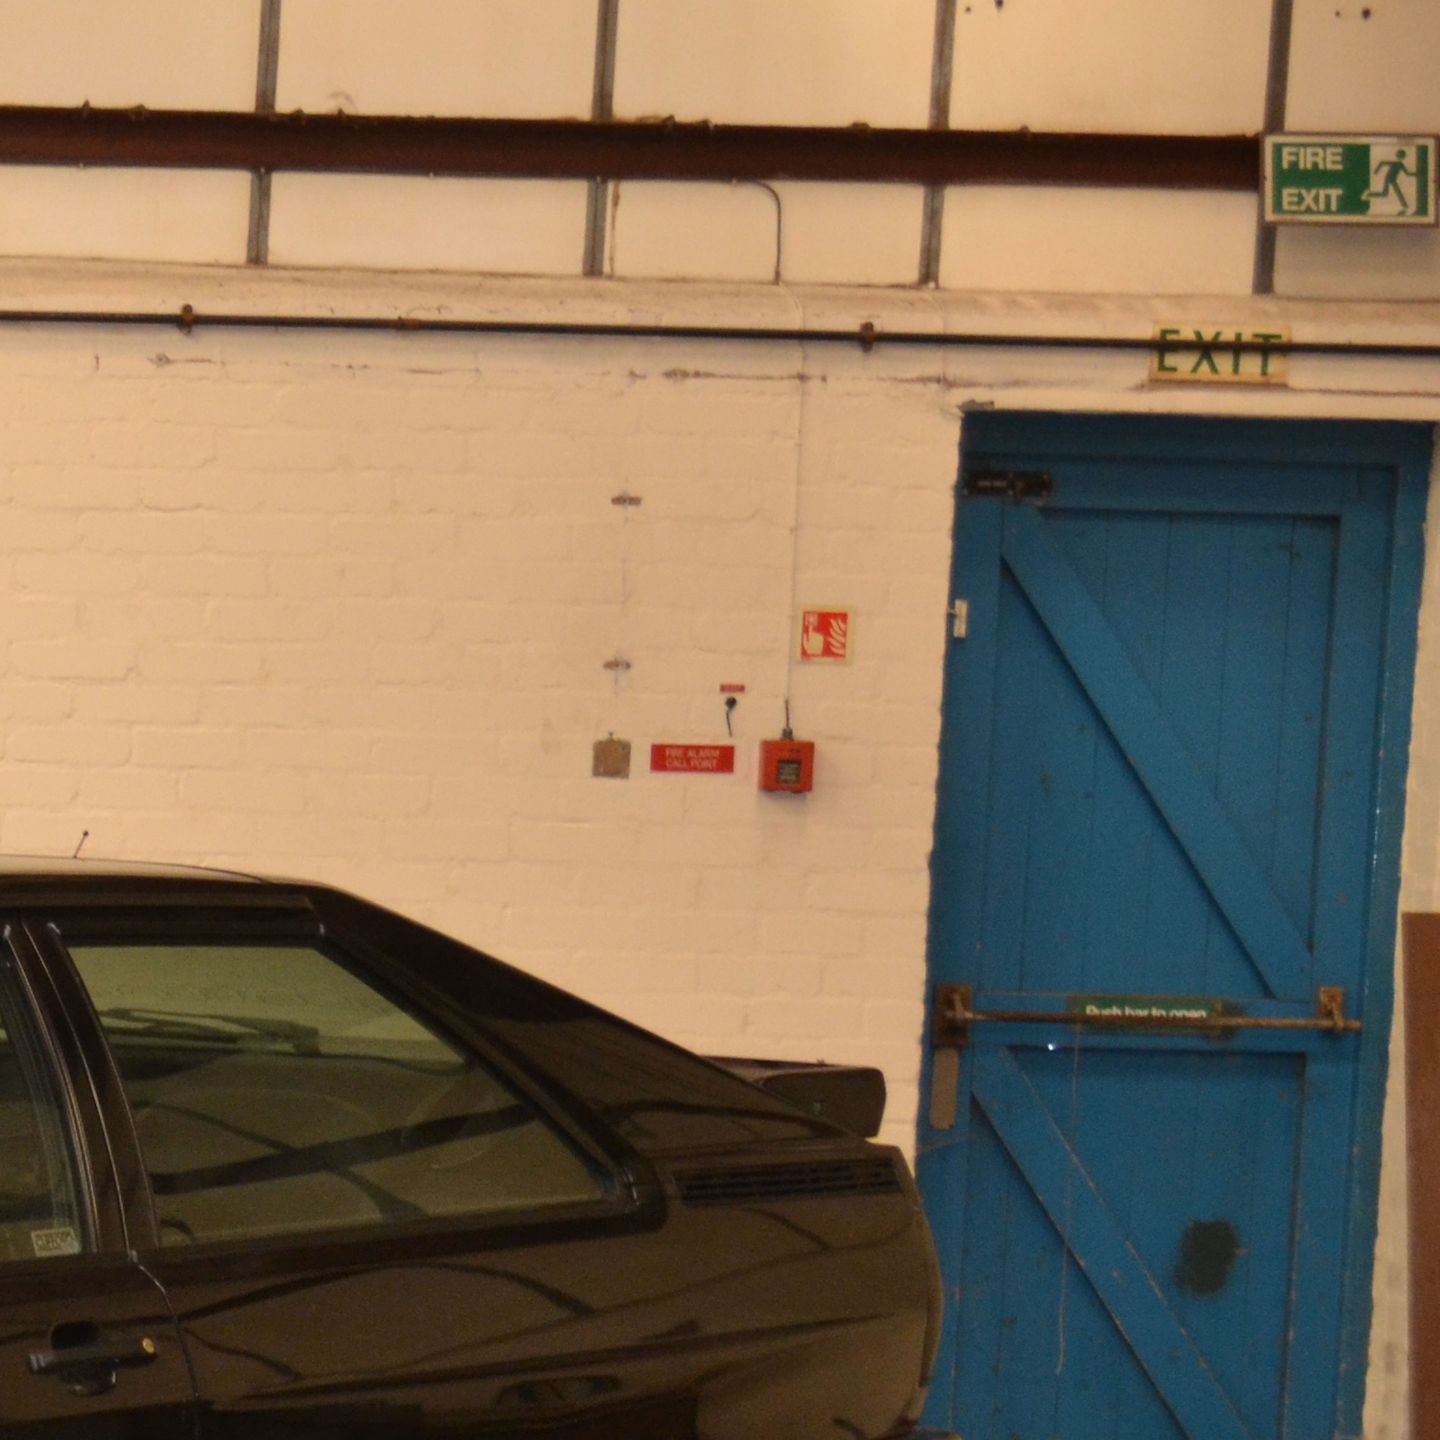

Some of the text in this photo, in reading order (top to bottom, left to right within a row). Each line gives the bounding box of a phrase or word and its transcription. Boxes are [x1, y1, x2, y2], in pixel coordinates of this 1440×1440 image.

[1281, 147, 1343, 170] FIRE
[1281, 187, 1343, 212] EXIT
[1157, 329, 1282, 376] EXIT
